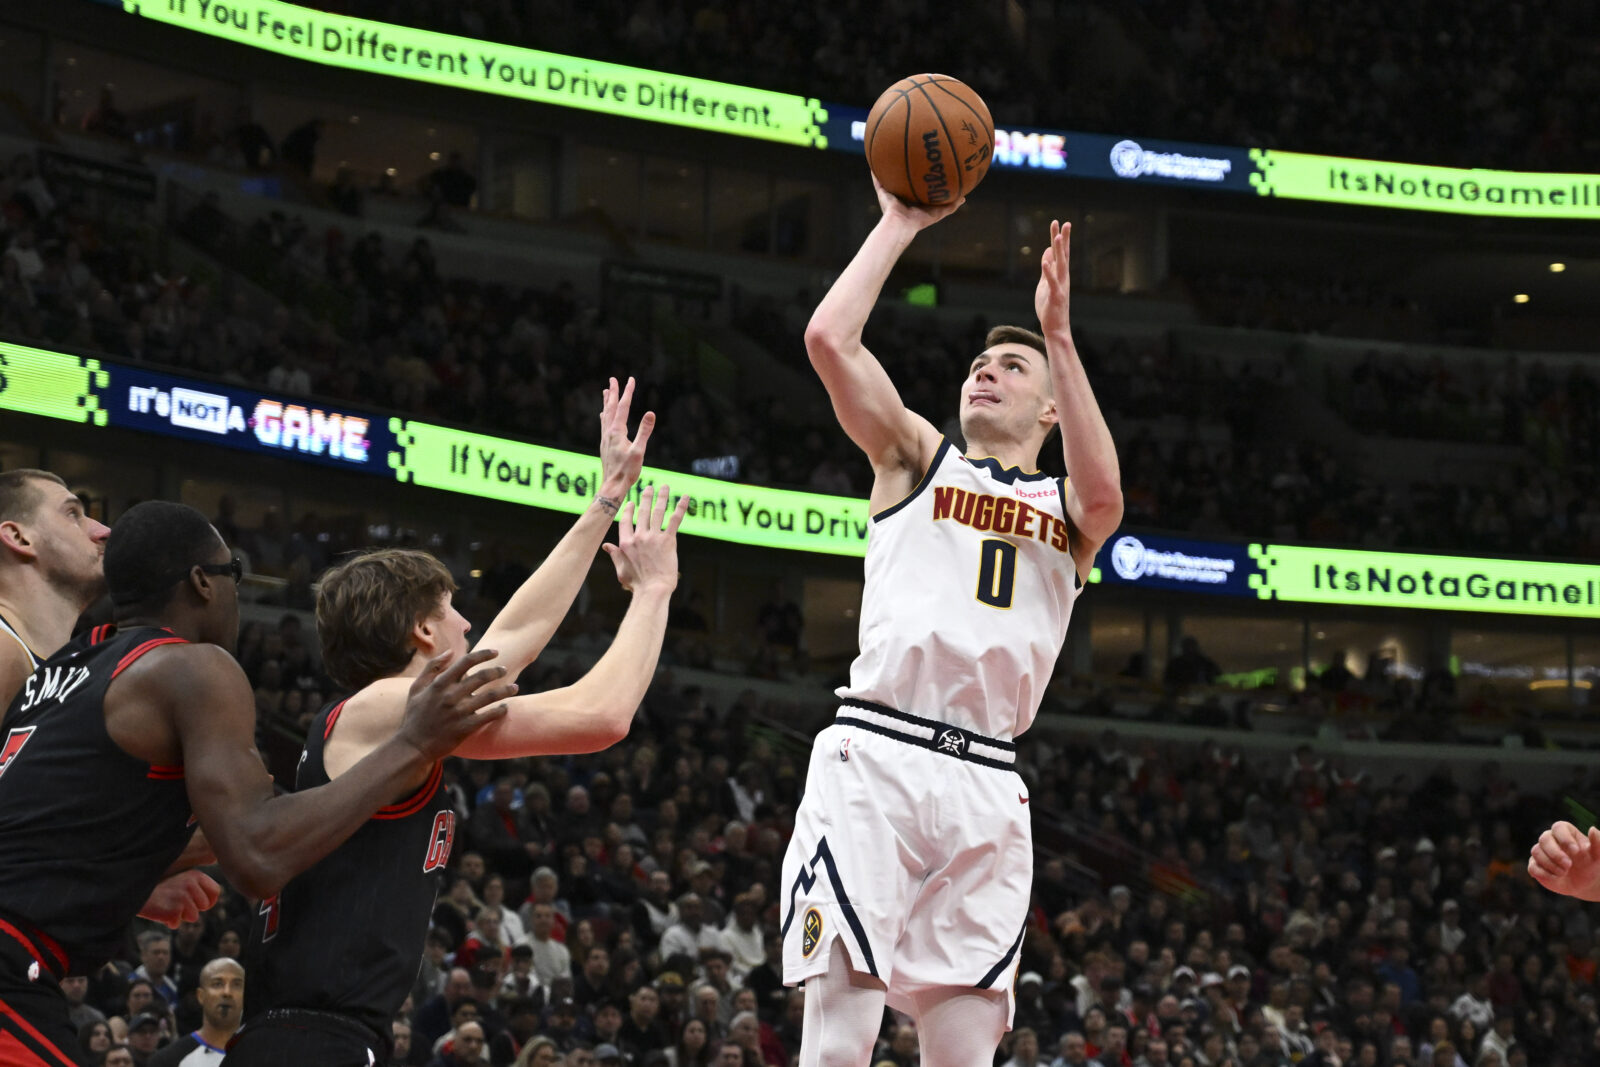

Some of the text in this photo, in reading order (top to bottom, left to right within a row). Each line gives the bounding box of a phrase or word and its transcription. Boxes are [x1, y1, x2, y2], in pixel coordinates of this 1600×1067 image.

[198, 0, 249, 31] You
[257, 11, 314, 47] Feel
[323, 26, 469, 75] Different
[480, 56, 536, 87] You
[547, 67, 628, 102] Drive
[638, 82, 781, 129] Different.
[993, 129, 1067, 169] AME
[228, 405, 246, 432] A
[253, 399, 370, 463] GAME
[451, 444, 470, 475] If
[478, 449, 531, 487] You
[541, 461, 597, 497] Feel
[737, 500, 794, 532] You
[805, 508, 868, 540] Driv
[933, 486, 1069, 553] NUGGETS
[1015, 487, 1057, 499] ibotta
[975, 538, 1018, 610] 0
